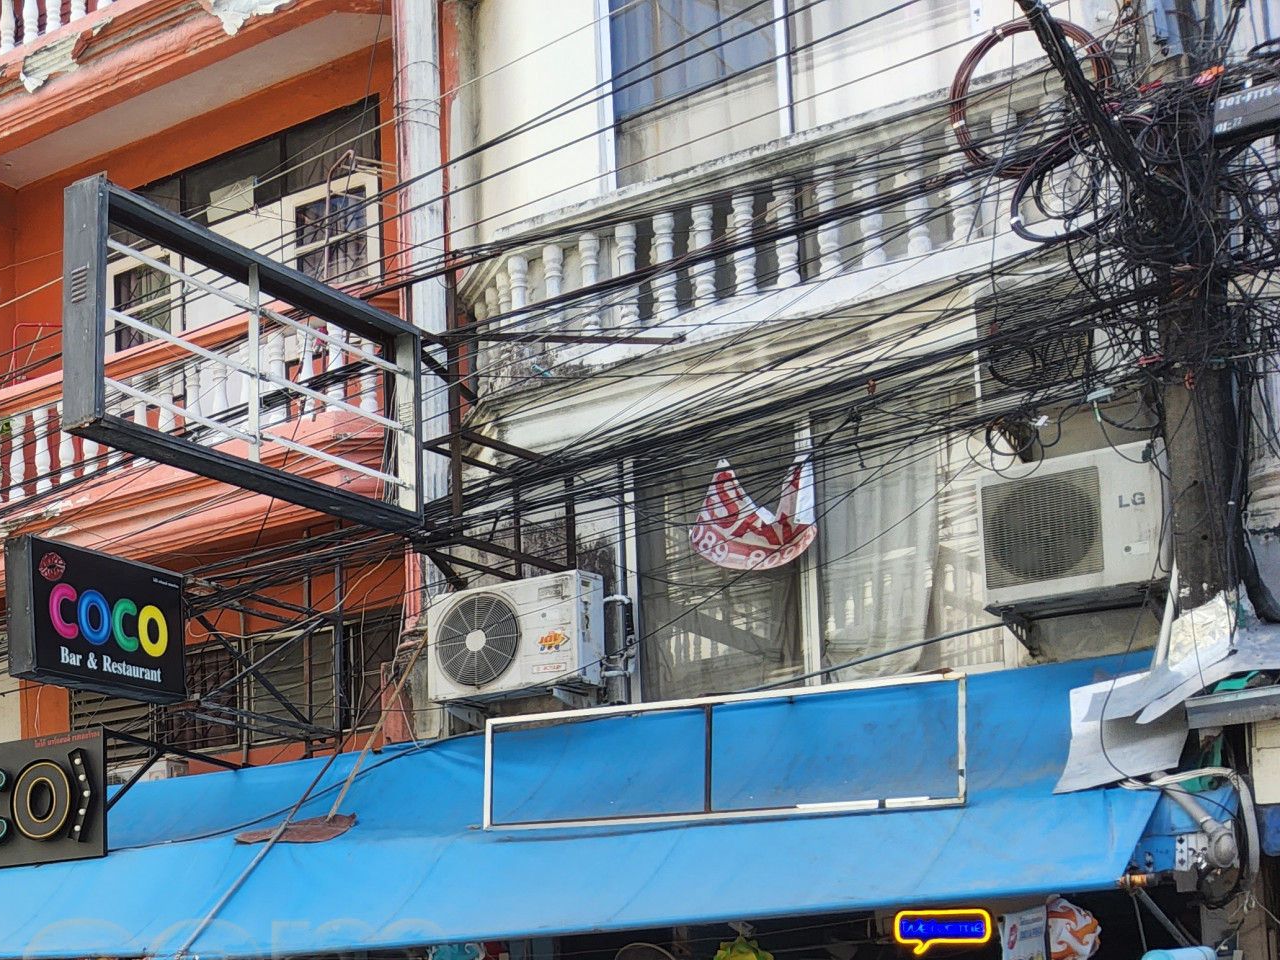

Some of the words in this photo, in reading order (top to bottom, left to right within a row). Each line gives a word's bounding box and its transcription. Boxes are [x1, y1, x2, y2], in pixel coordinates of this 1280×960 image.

[1118, 492, 1145, 508] LG
[49, 583, 168, 657] COCO
[60, 646, 82, 666] Bar
[87, 652, 98, 670] &
[102, 655, 162, 683] Restaurant
